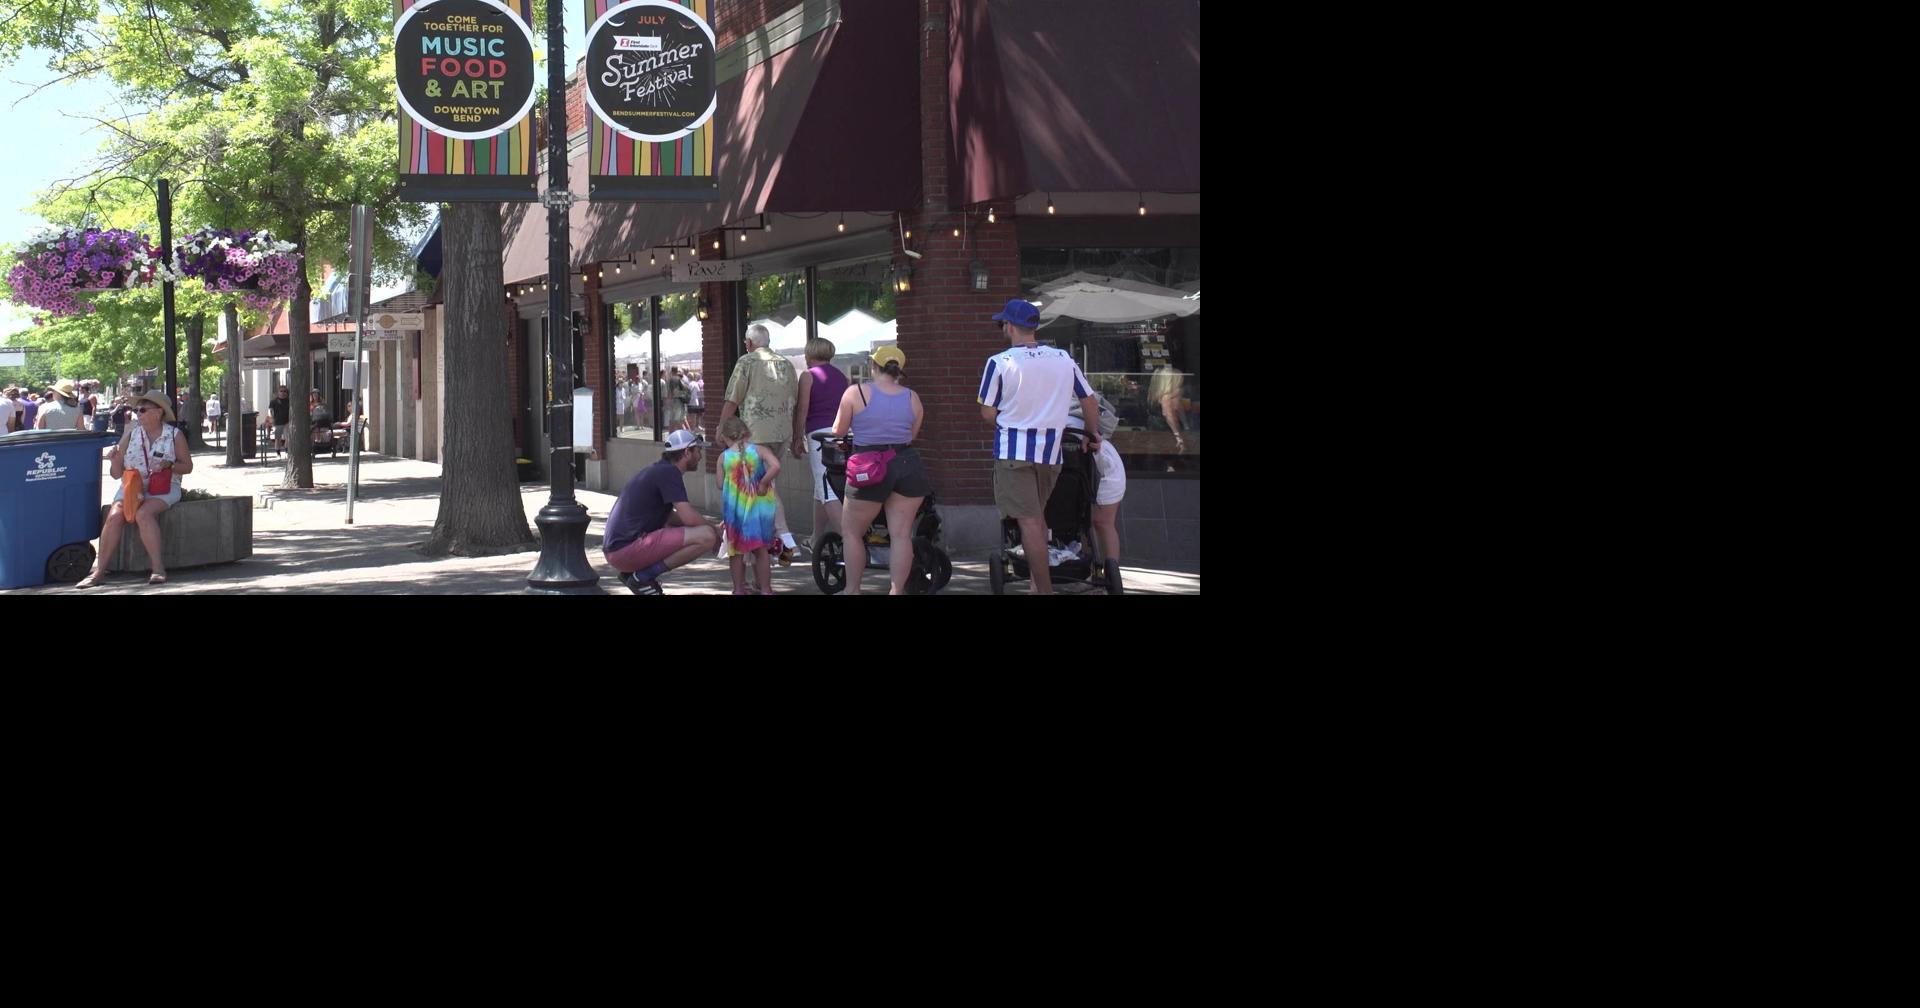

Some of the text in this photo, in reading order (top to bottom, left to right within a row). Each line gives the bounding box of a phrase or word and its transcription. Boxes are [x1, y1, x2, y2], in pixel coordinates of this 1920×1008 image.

[446, 15, 477, 24] COME
[637, 15, 666, 25] JULY
[423, 22, 503, 33] TOGETHER FOR
[421, 36, 505, 57] MUSIC
[421, 57, 507, 79] FOOD
[601, 43, 702, 87] Summer
[425, 79, 504, 99] & ART
[620, 64, 694, 102] Festival
[433, 105, 500, 115] DOWNTOWN
[453, 114, 481, 122] BEND
